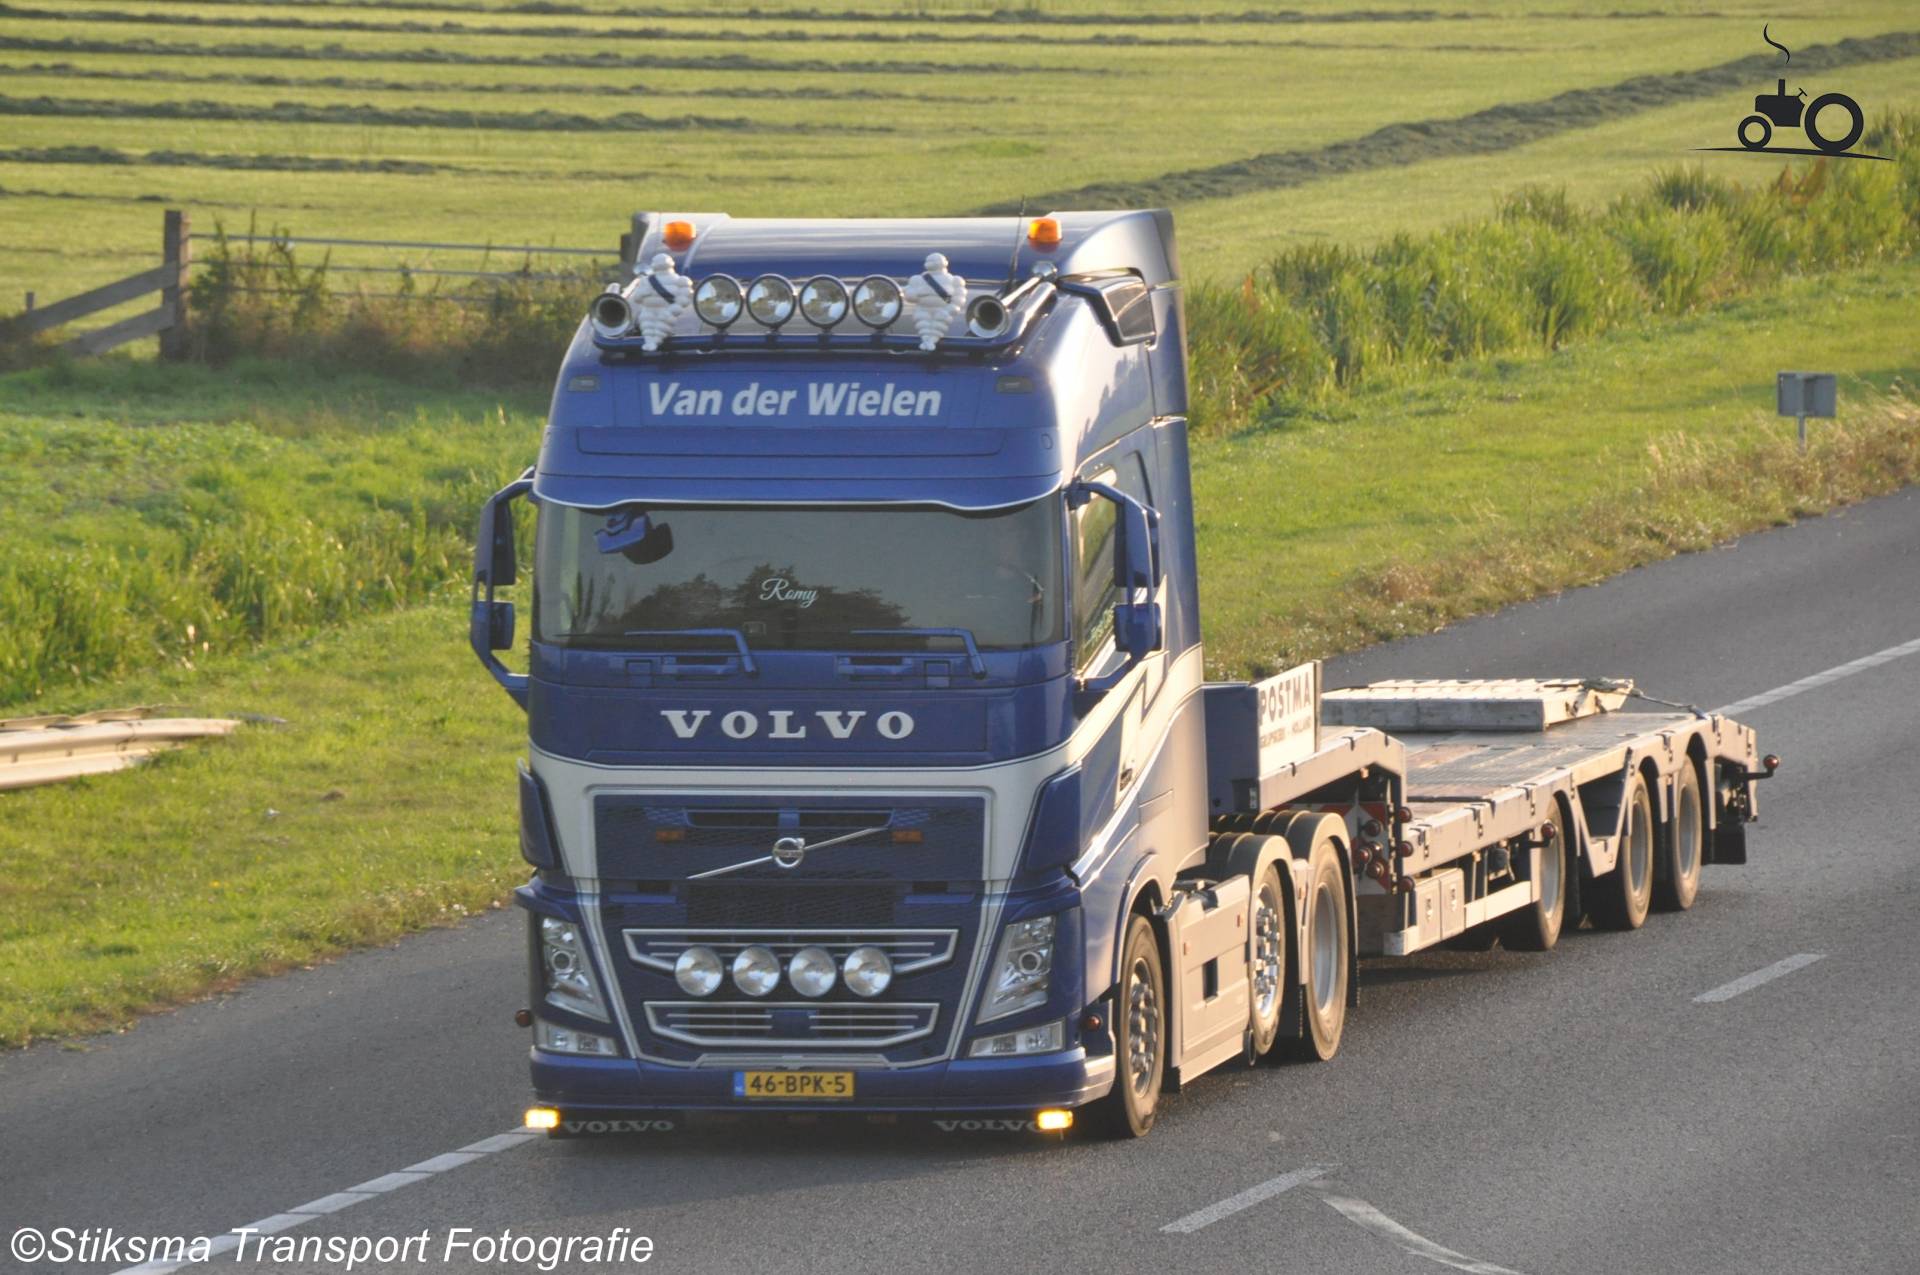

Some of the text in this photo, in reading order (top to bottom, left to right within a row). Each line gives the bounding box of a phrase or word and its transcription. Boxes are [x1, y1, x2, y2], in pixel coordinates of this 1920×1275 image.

[649, 382, 942, 416] Van der Wielen
[760, 578, 817, 609] Romy
[1258, 672, 1312, 727] POSTMA
[660, 710, 915, 739] VOLVO
[750, 1075, 846, 1093] 46-BPK-5
[563, 1120, 674, 1133] VOLVO
